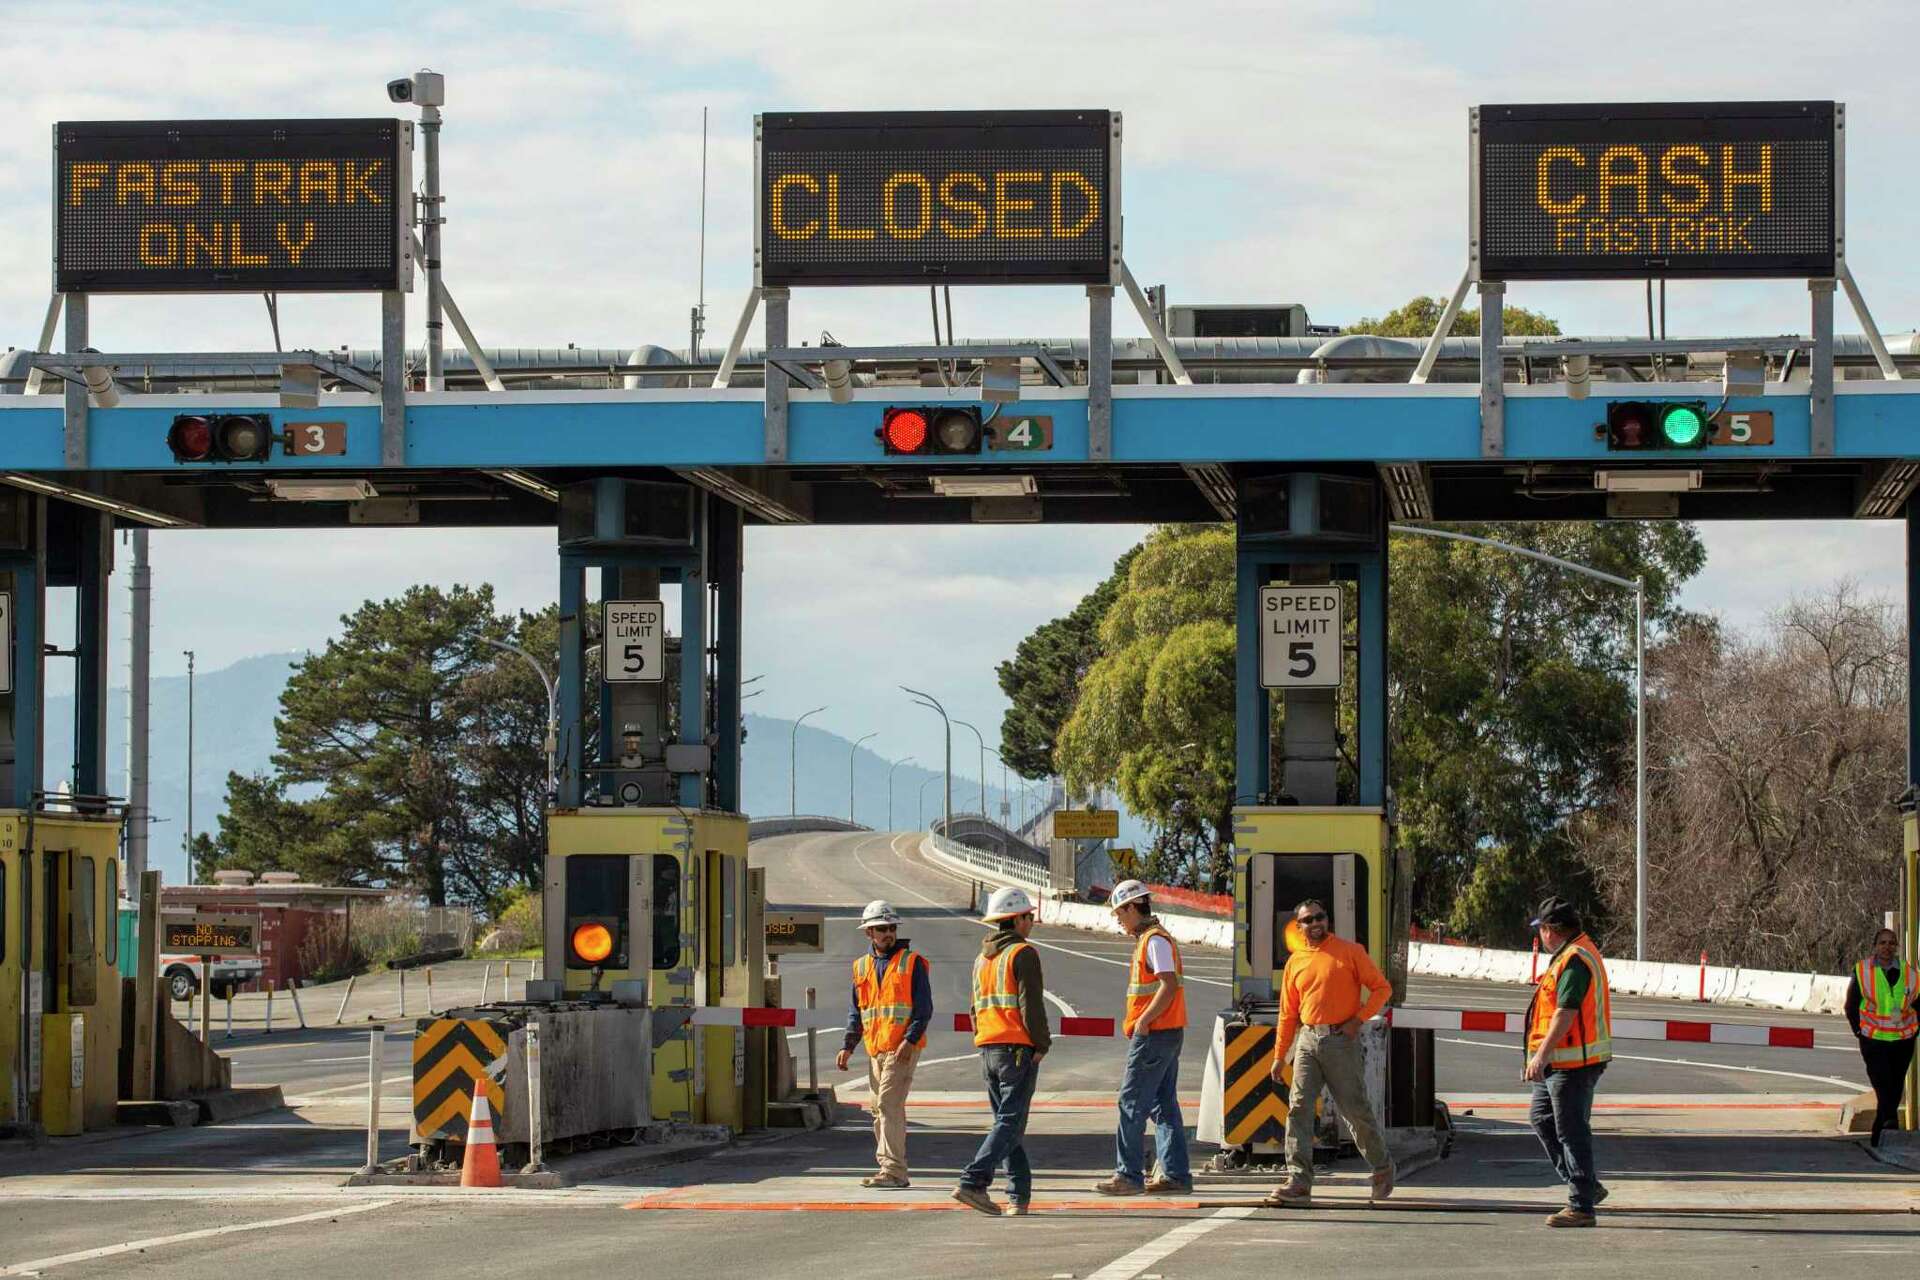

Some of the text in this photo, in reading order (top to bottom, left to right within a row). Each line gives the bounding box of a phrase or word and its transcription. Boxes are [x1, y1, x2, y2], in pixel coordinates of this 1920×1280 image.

[71, 161, 384, 206] FASTRAK
[1537, 144, 1772, 214] CASH
[771, 171, 1099, 241] CLOSED
[140, 221, 316, 266] ONLY
[1556, 216, 1755, 252] FASTRAK
[304, 424, 326, 452] 3
[1007, 419, 1033, 447] 4
[1730, 414, 1752, 442] 5
[611, 612, 657, 624] SPEED
[1266, 596, 1337, 612] SPEED
[616, 626, 653, 638] LIMIT
[1273, 619, 1331, 634] LIMIT
[623, 644, 645, 673] 5
[1288, 642, 1317, 678] 5
[172, 935, 236, 946] STOPPING
[196, 922, 212, 935] NO
